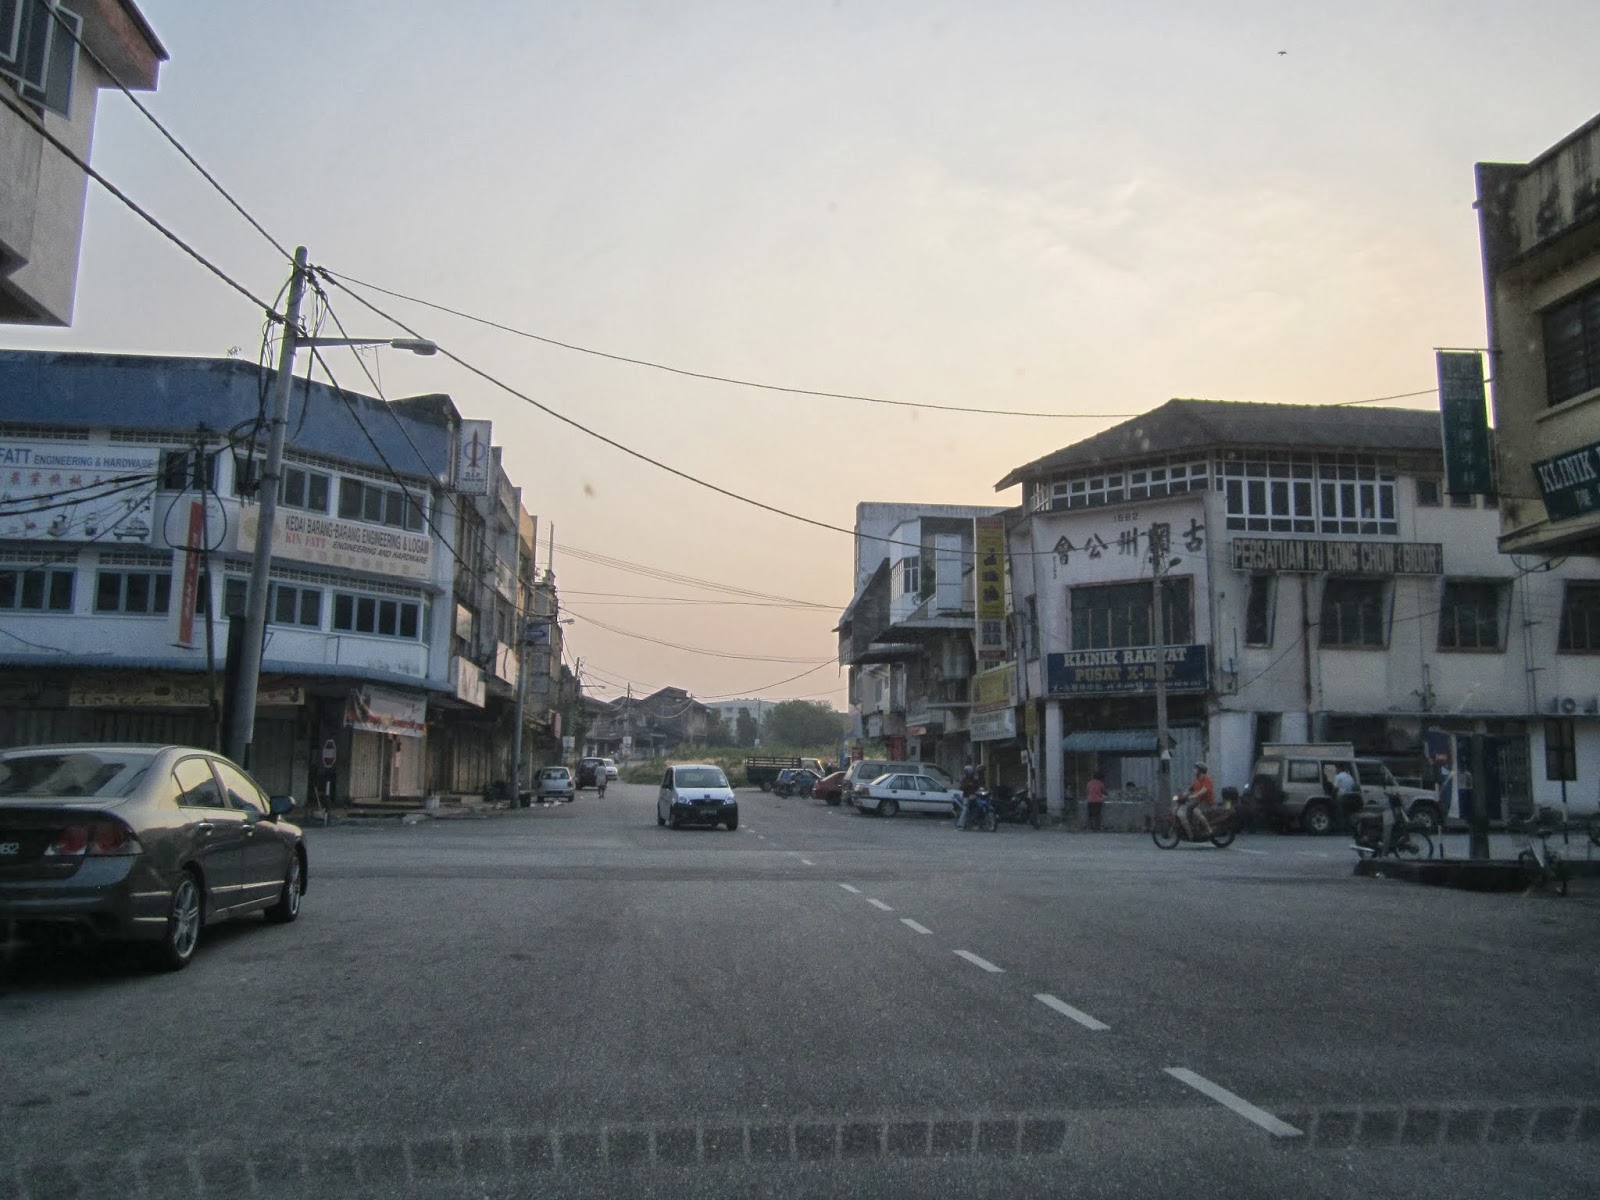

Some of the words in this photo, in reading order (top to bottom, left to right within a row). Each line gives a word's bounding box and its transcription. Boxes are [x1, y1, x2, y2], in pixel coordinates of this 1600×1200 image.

[34, 455, 93, 467] ENGINEERING
[95, 457, 101, 467] &
[103, 457, 154, 469] HARDWARE
[1538, 450, 1597, 493] KLINIK
[286, 515, 306, 532] KEDAI
[306, 519, 361, 542] BARANG-BARANG
[361, 528, 401, 550] ENGINEERING
[402, 538, 408, 550] &
[408, 536, 430, 554] LOGAM
[305, 535, 327, 549] FATT
[332, 541, 377, 556] ENGINEERING
[377, 549, 391, 558] AND
[391, 552, 428, 564] HARDWARE
[1234, 539, 1305, 570] PERSATUAN
[1327, 542, 1358, 571] KONG
[1360, 543, 1395, 573] CHOW
[1063, 651, 1119, 667] KLINIK
[1074, 666, 1122, 682] PUSAT
[1127, 664, 1176, 681] X-RY
